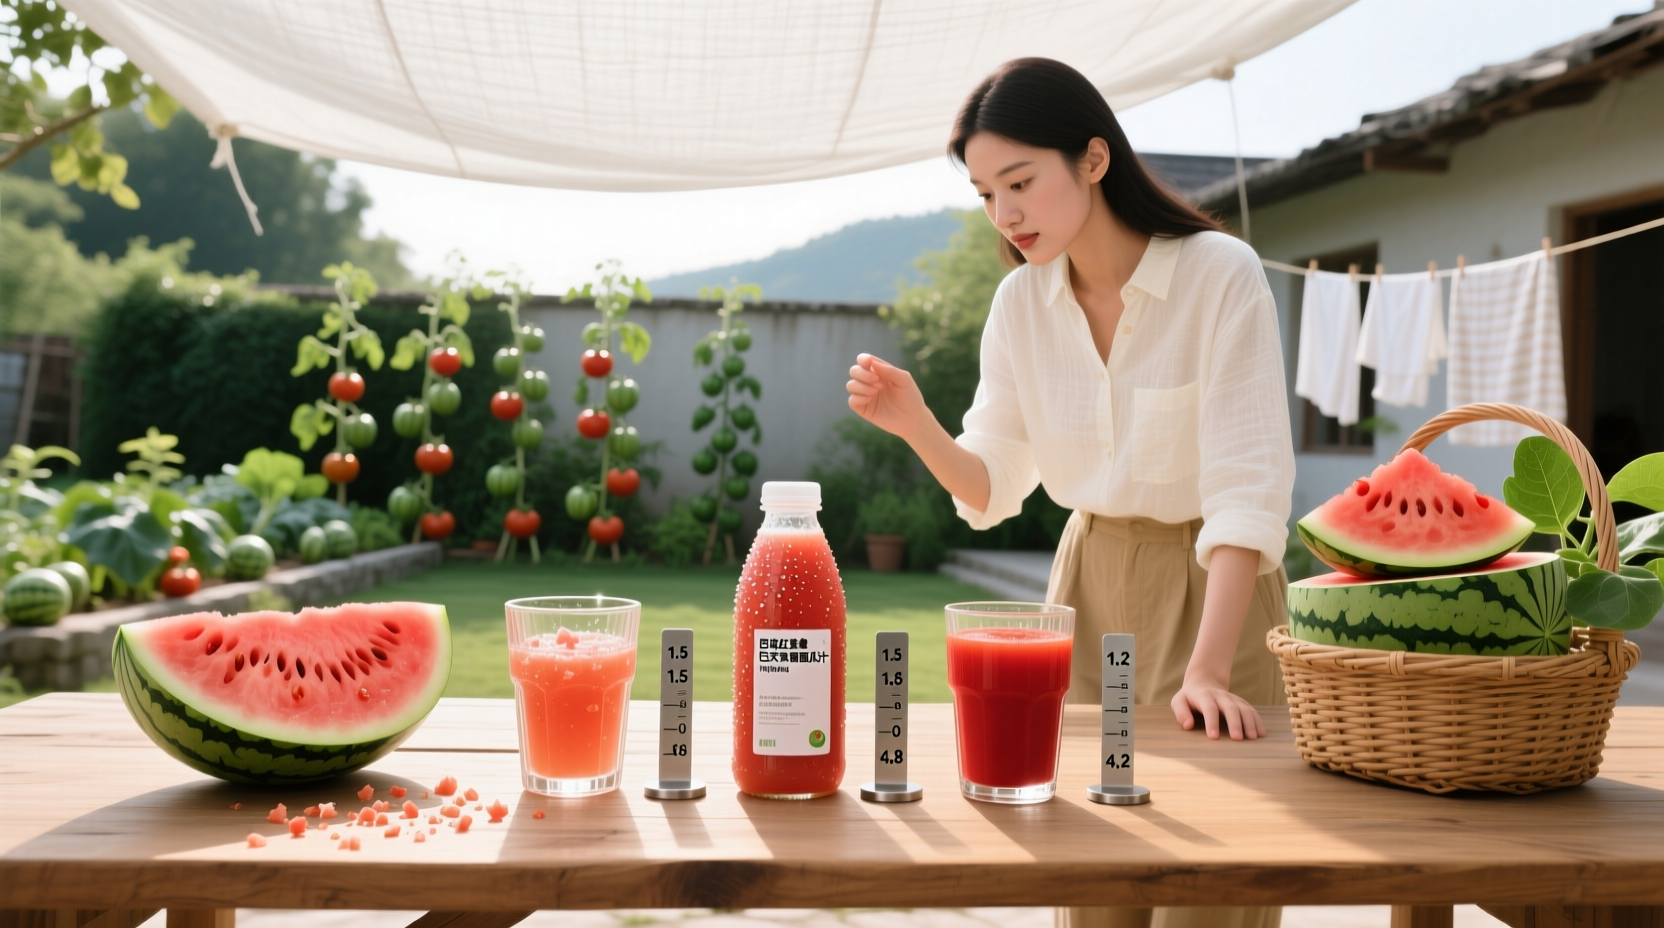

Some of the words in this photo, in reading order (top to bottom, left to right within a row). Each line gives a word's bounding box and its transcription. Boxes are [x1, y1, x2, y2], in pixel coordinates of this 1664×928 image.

[668, 646, 688, 659] 1.5
[882, 648, 902, 661] 1.5
[1107, 651, 1130, 666] 1.2
[880, 749, 903, 764] 4.8
[1105, 753, 1130, 769] 4.2
